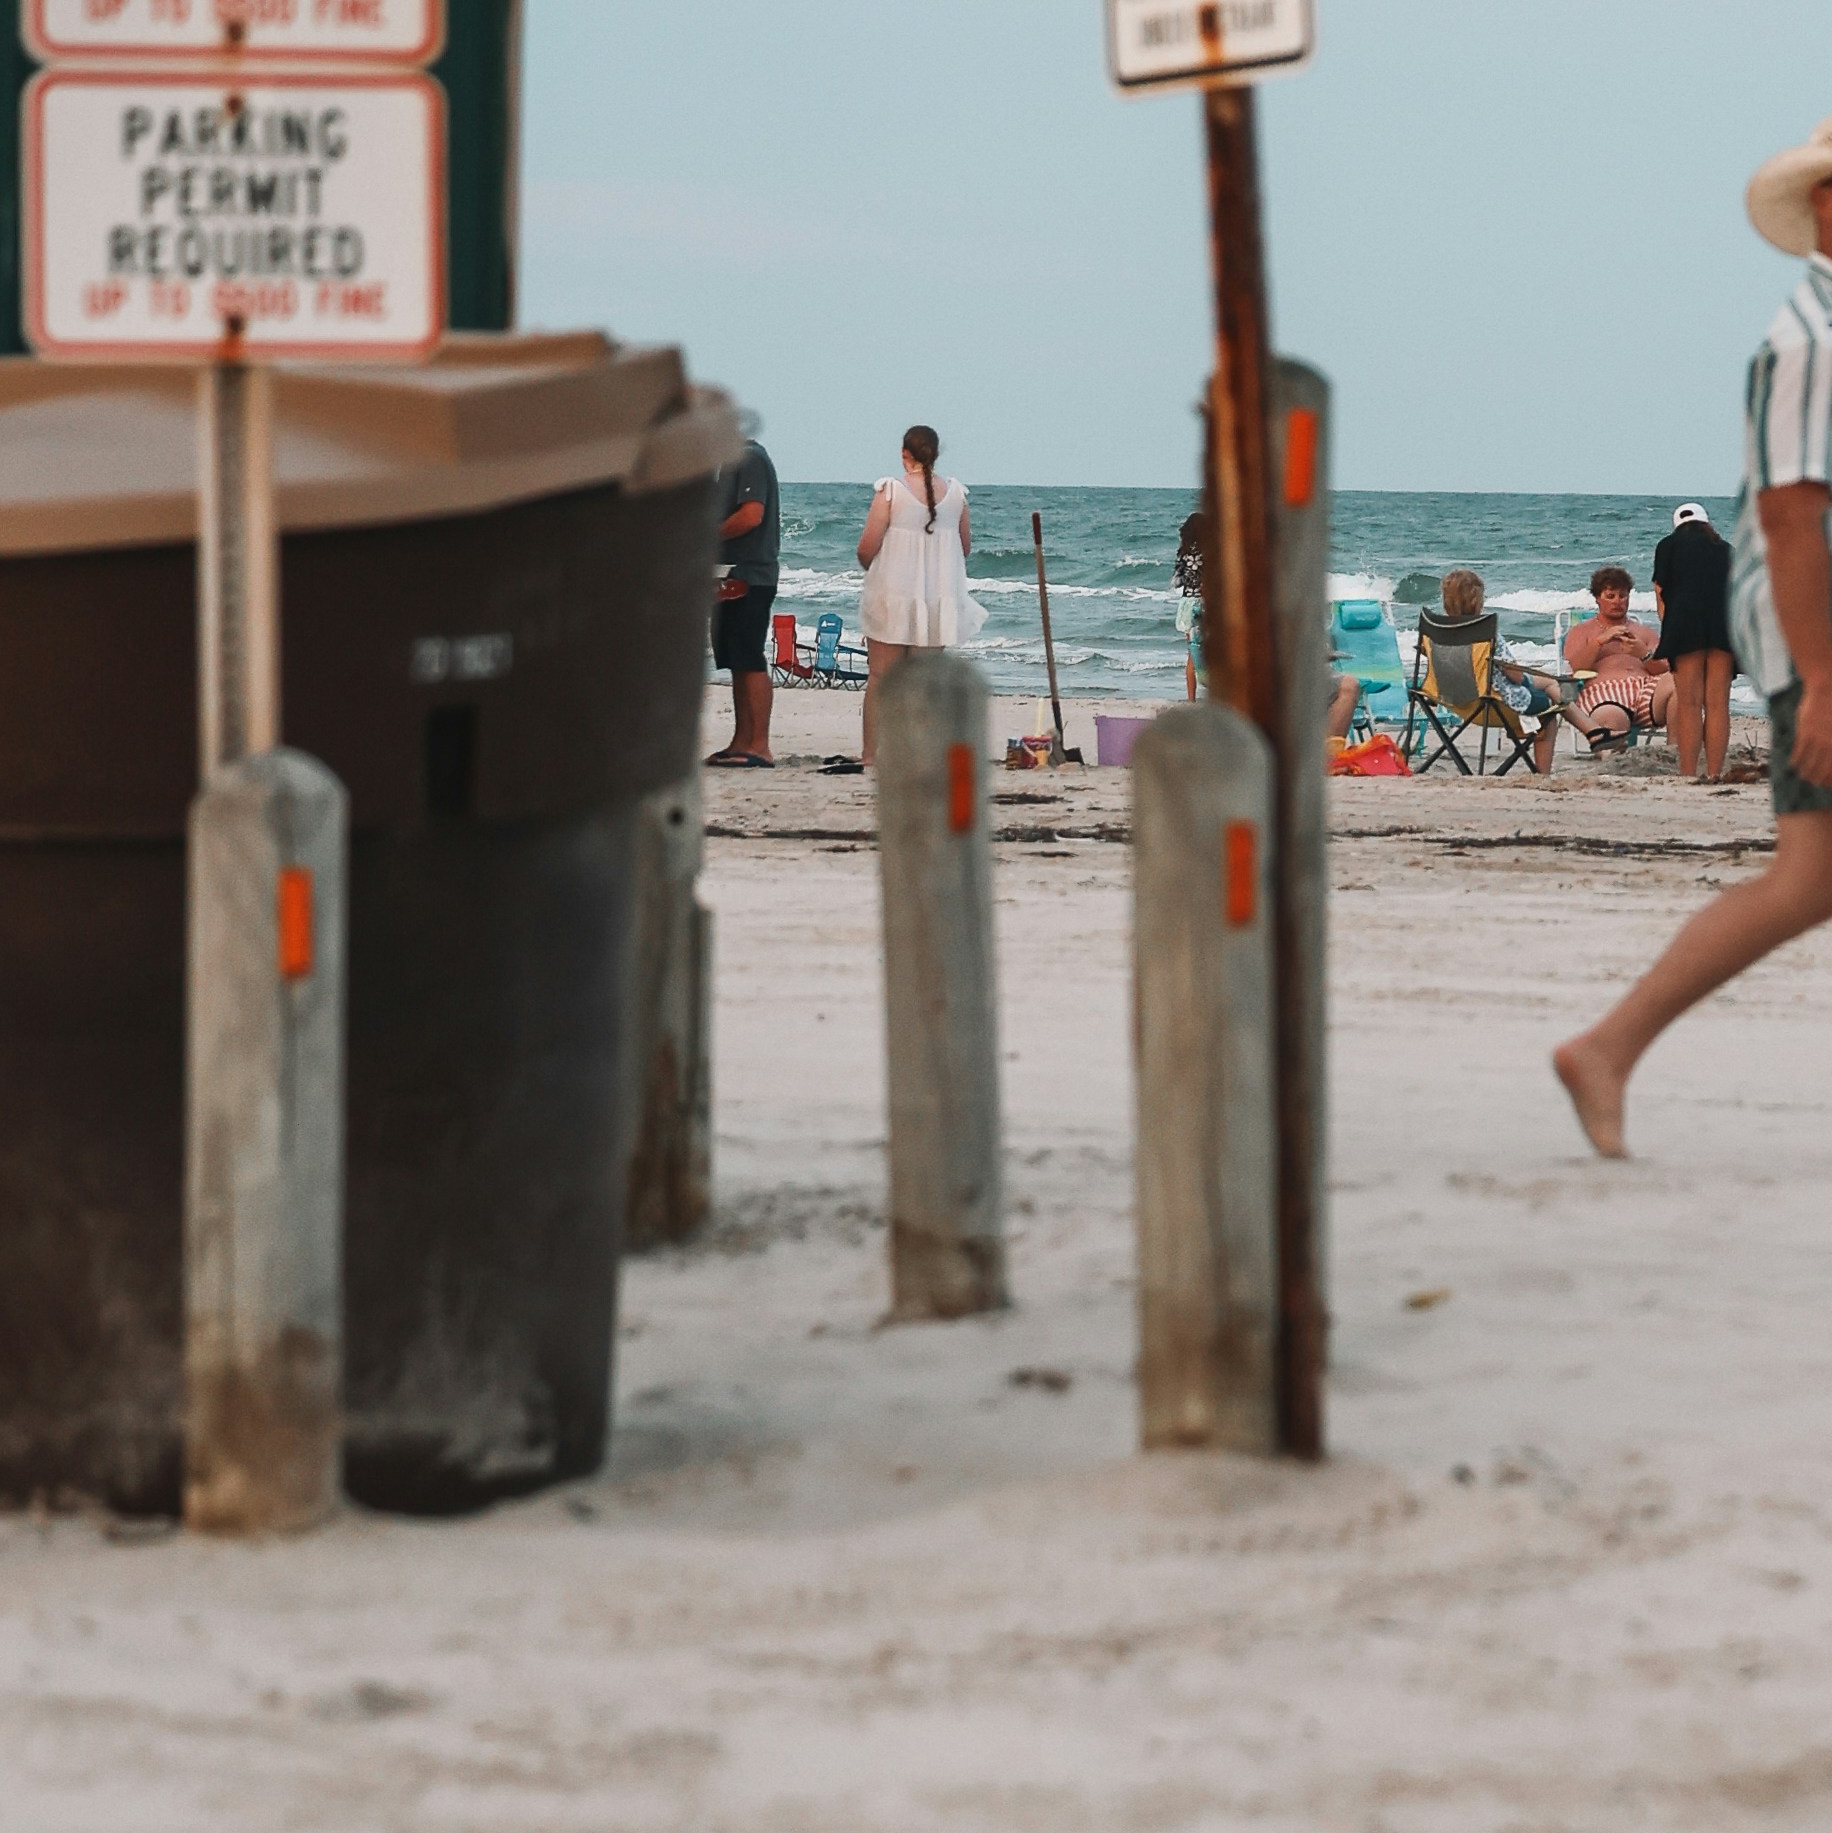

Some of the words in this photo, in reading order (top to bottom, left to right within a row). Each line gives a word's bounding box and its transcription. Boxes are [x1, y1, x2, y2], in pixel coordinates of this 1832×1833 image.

[121, 106, 348, 162] PARKING
[141, 165, 327, 220] PERMIT
[107, 225, 365, 281] REQUIRED
[83, 283, 129, 321] UP
[150, 284, 190, 321] TO
[315, 285, 389, 322] FINE
